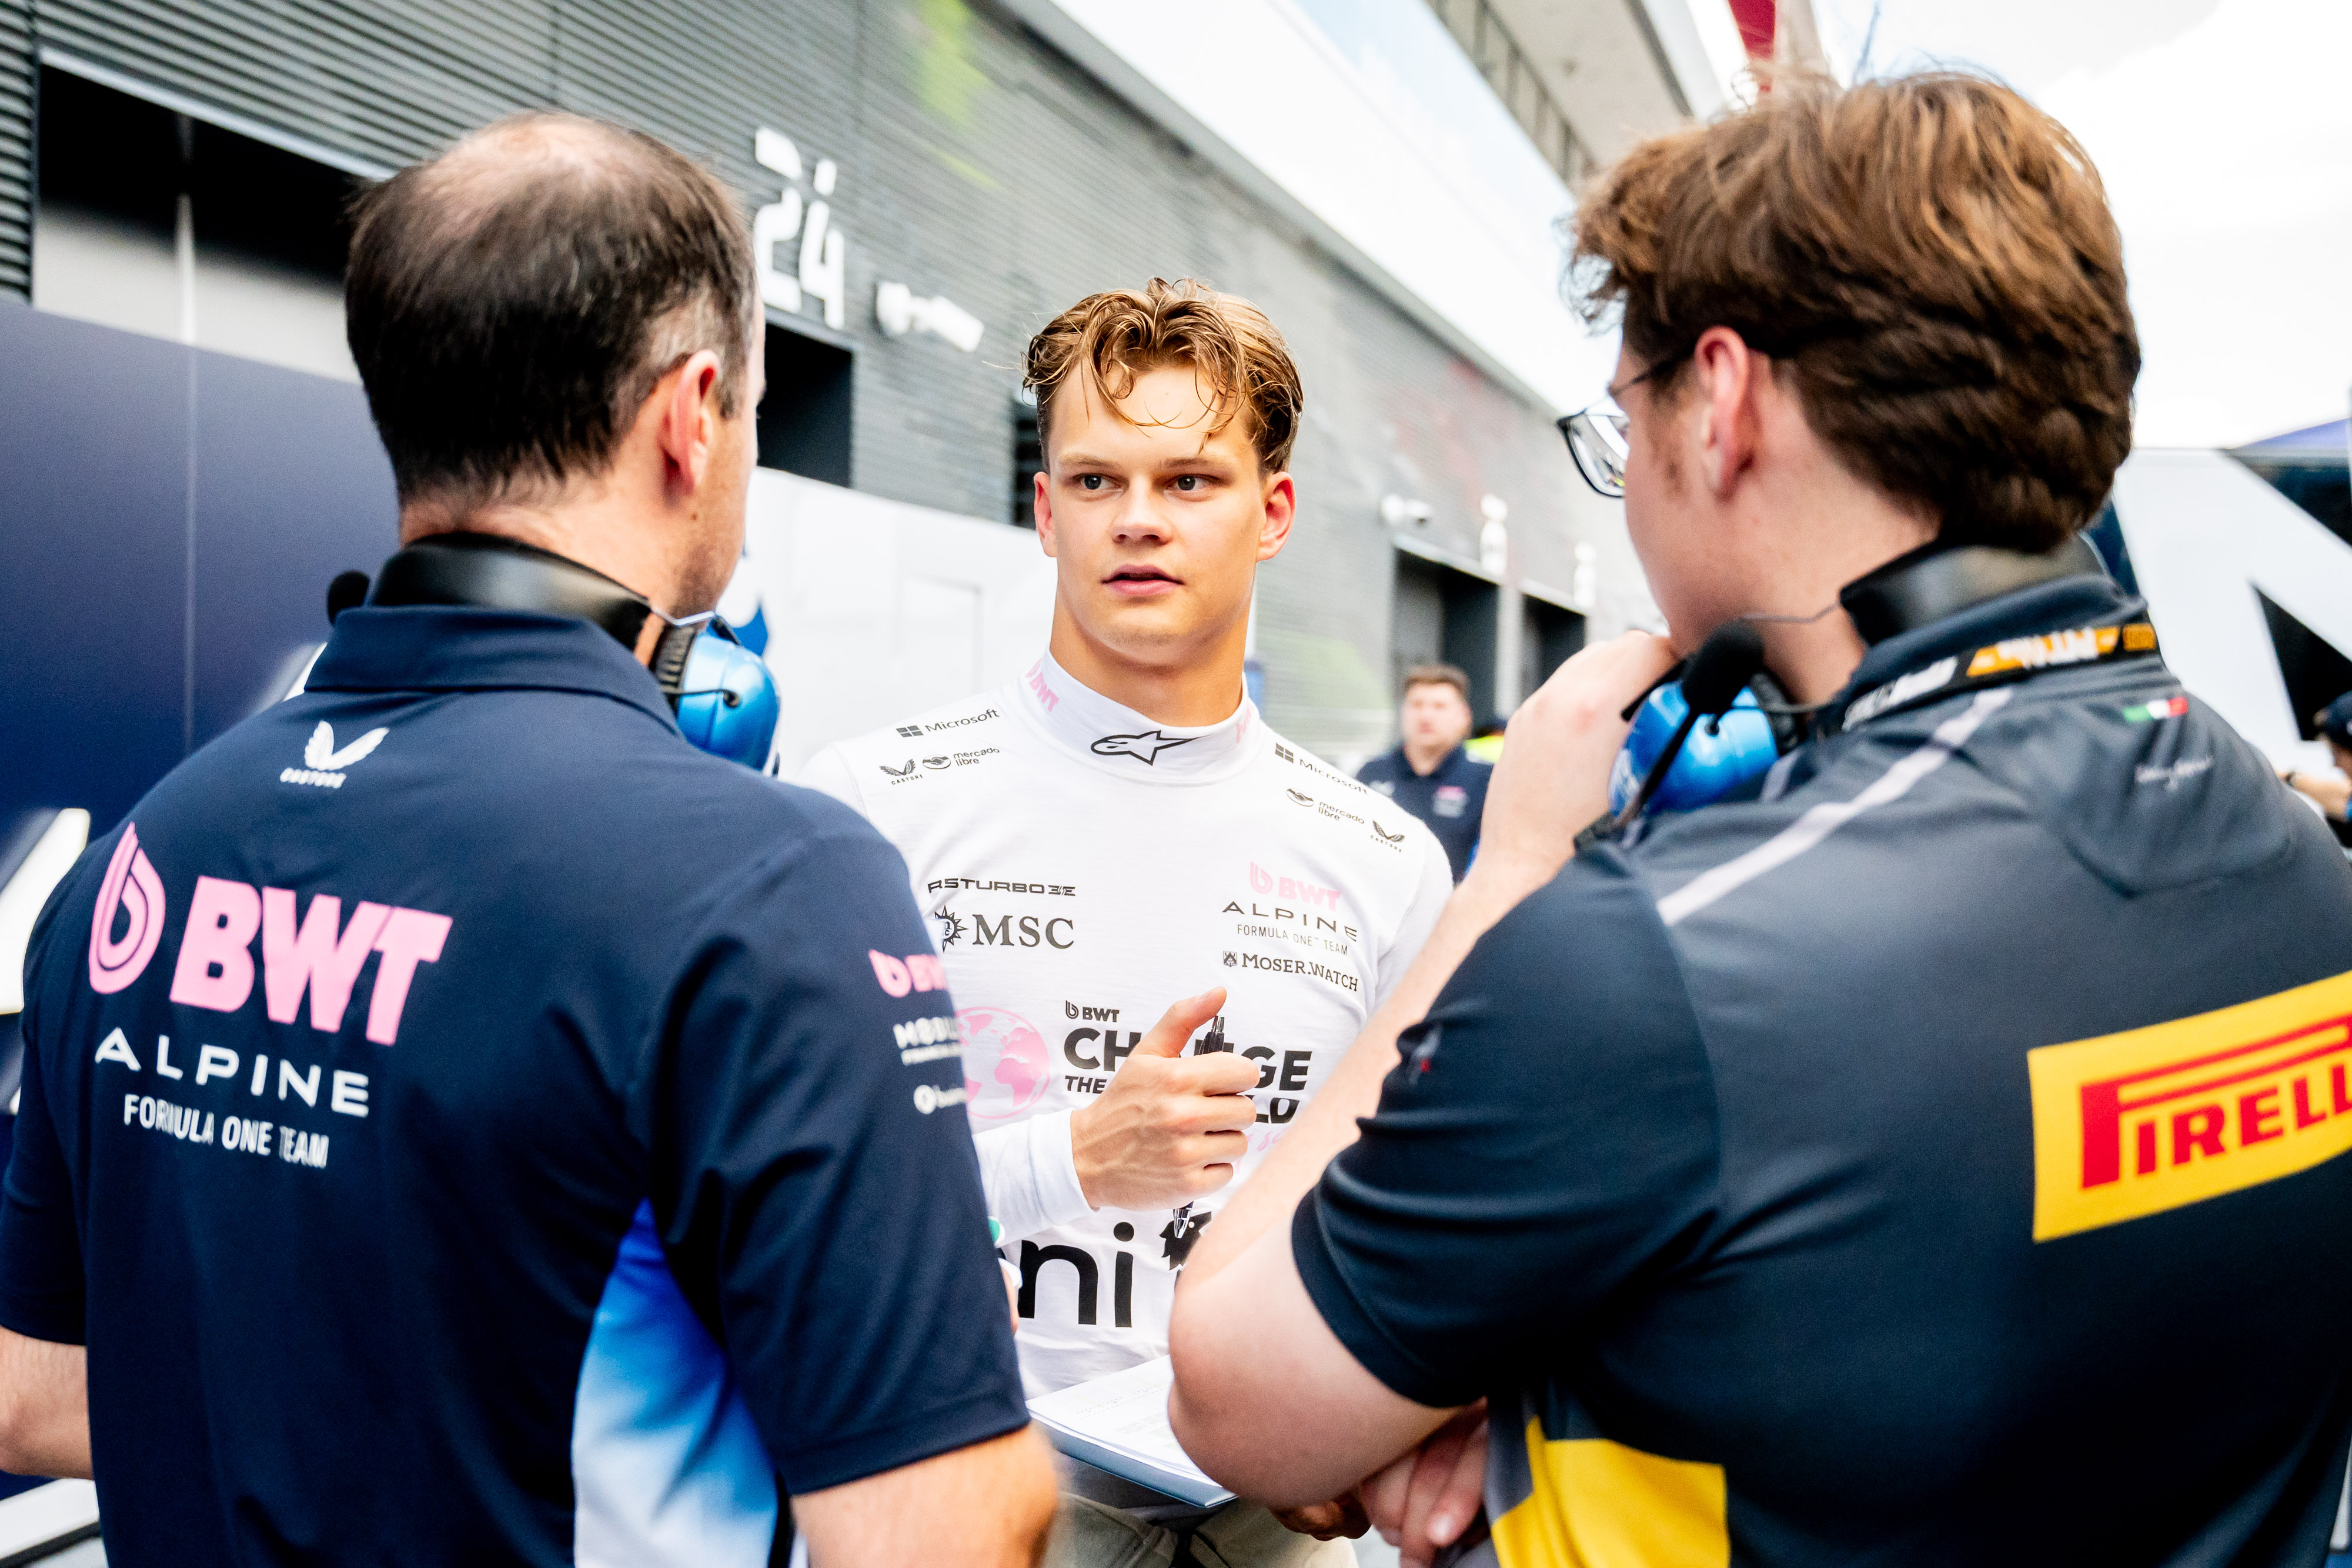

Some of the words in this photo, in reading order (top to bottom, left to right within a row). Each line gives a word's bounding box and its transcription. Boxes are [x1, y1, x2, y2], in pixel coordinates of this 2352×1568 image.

[754, 127, 845, 330] 24
[1029, 671, 1060, 713] BWT
[925, 709, 1000, 733] Microsoft
[953, 747, 1000, 759] mercado
[956, 757, 980, 767] libre
[891, 774, 924, 785] CASTORE
[1299, 758, 1368, 795] Microsoft
[1318, 806, 1340, 821] libre
[1319, 801, 1365, 824] mercado
[1370, 835, 1402, 853] CASTORE
[1278, 876, 1341, 911] BWT
[972, 914, 1074, 949] MSC
[1222, 901, 1357, 942] ALPINE
[1237, 924, 1289, 940] FORMULA
[1323, 940, 1348, 956] TEAM
[169, 875, 453, 1046] BWT
[1241, 952, 1358, 992] MOSER.WATCH
[1082, 1006, 1120, 1022] BWT
[95, 1027, 369, 1118] ALPINE
[1064, 1027, 1312, 1091] CHGE
[1064, 1075, 1108, 1094] THE
[222, 1116, 272, 1156] ONE
[279, 1125, 329, 1169] TEAM
